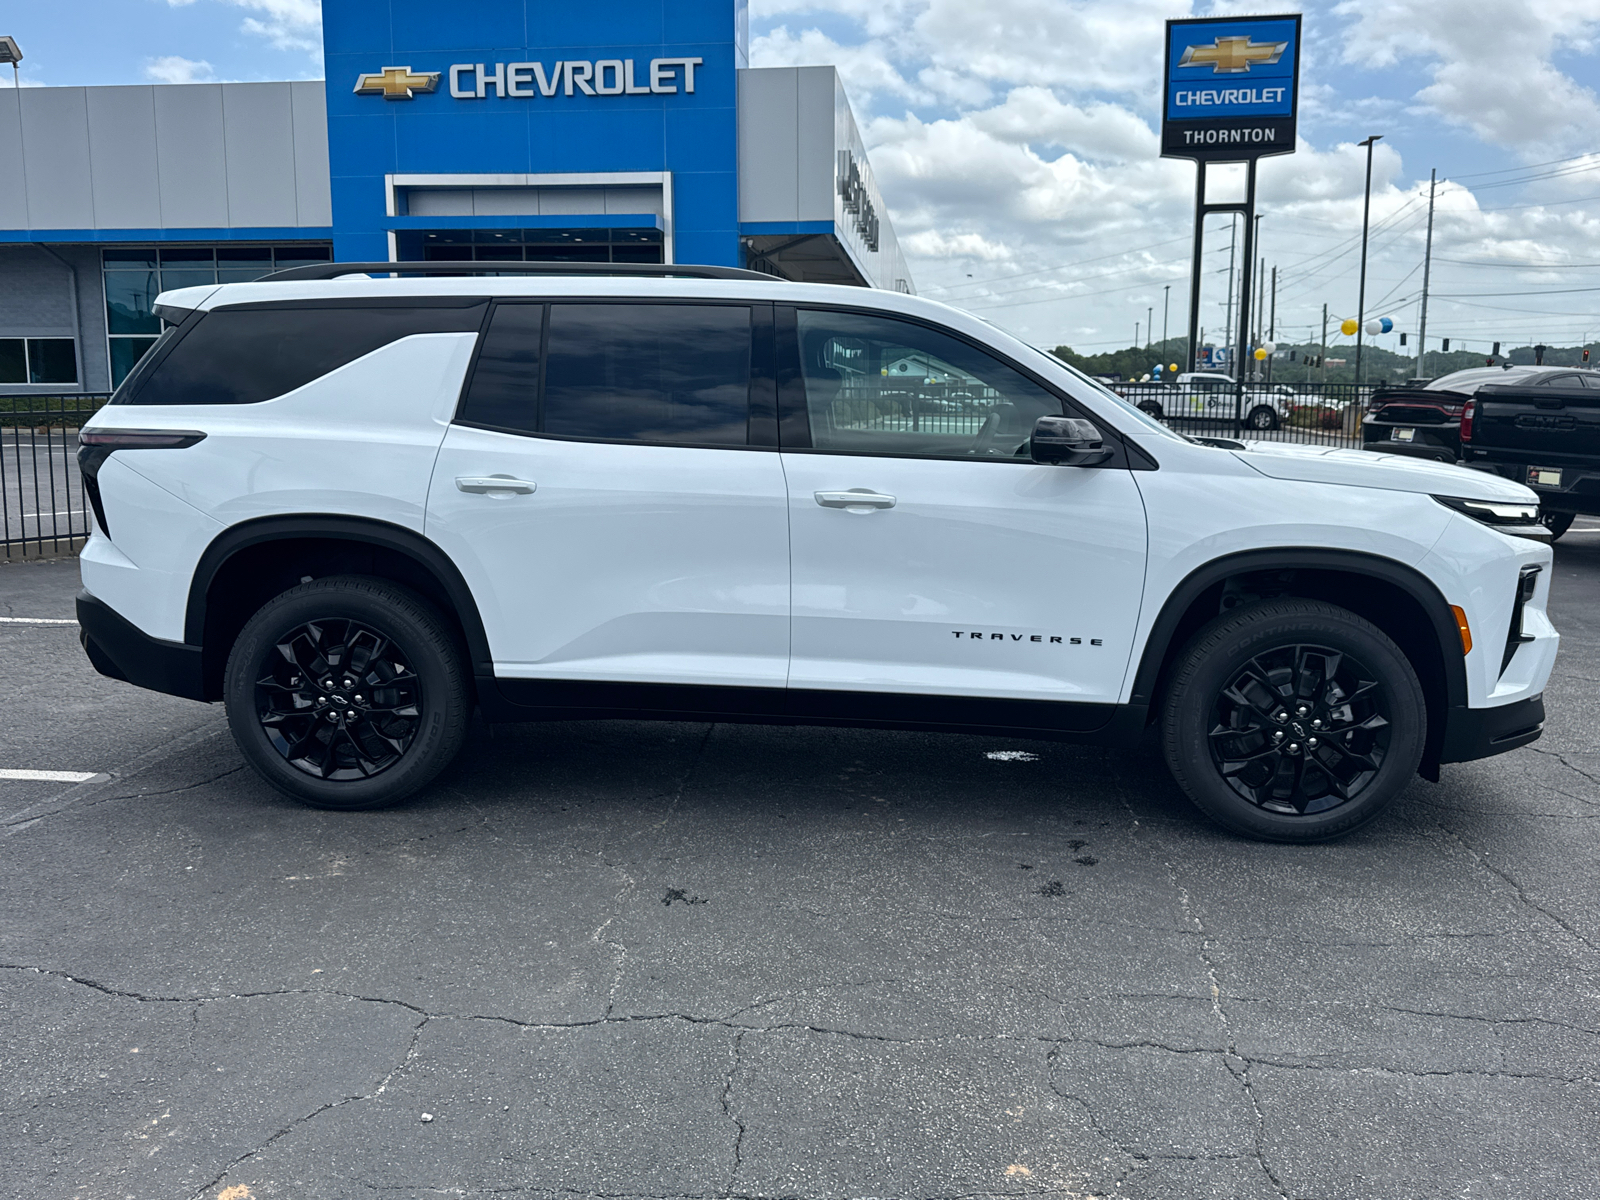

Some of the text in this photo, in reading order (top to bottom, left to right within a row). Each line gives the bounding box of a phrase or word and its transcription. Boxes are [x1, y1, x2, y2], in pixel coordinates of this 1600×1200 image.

[450, 57, 703, 98] CHEVROLET
[1176, 87, 1286, 106] CHEVROLET
[1184, 128, 1275, 144] THORNTON
[952, 631, 1103, 646] TRAVERSE
[1227, 622, 1360, 657] CONTINENTAL
